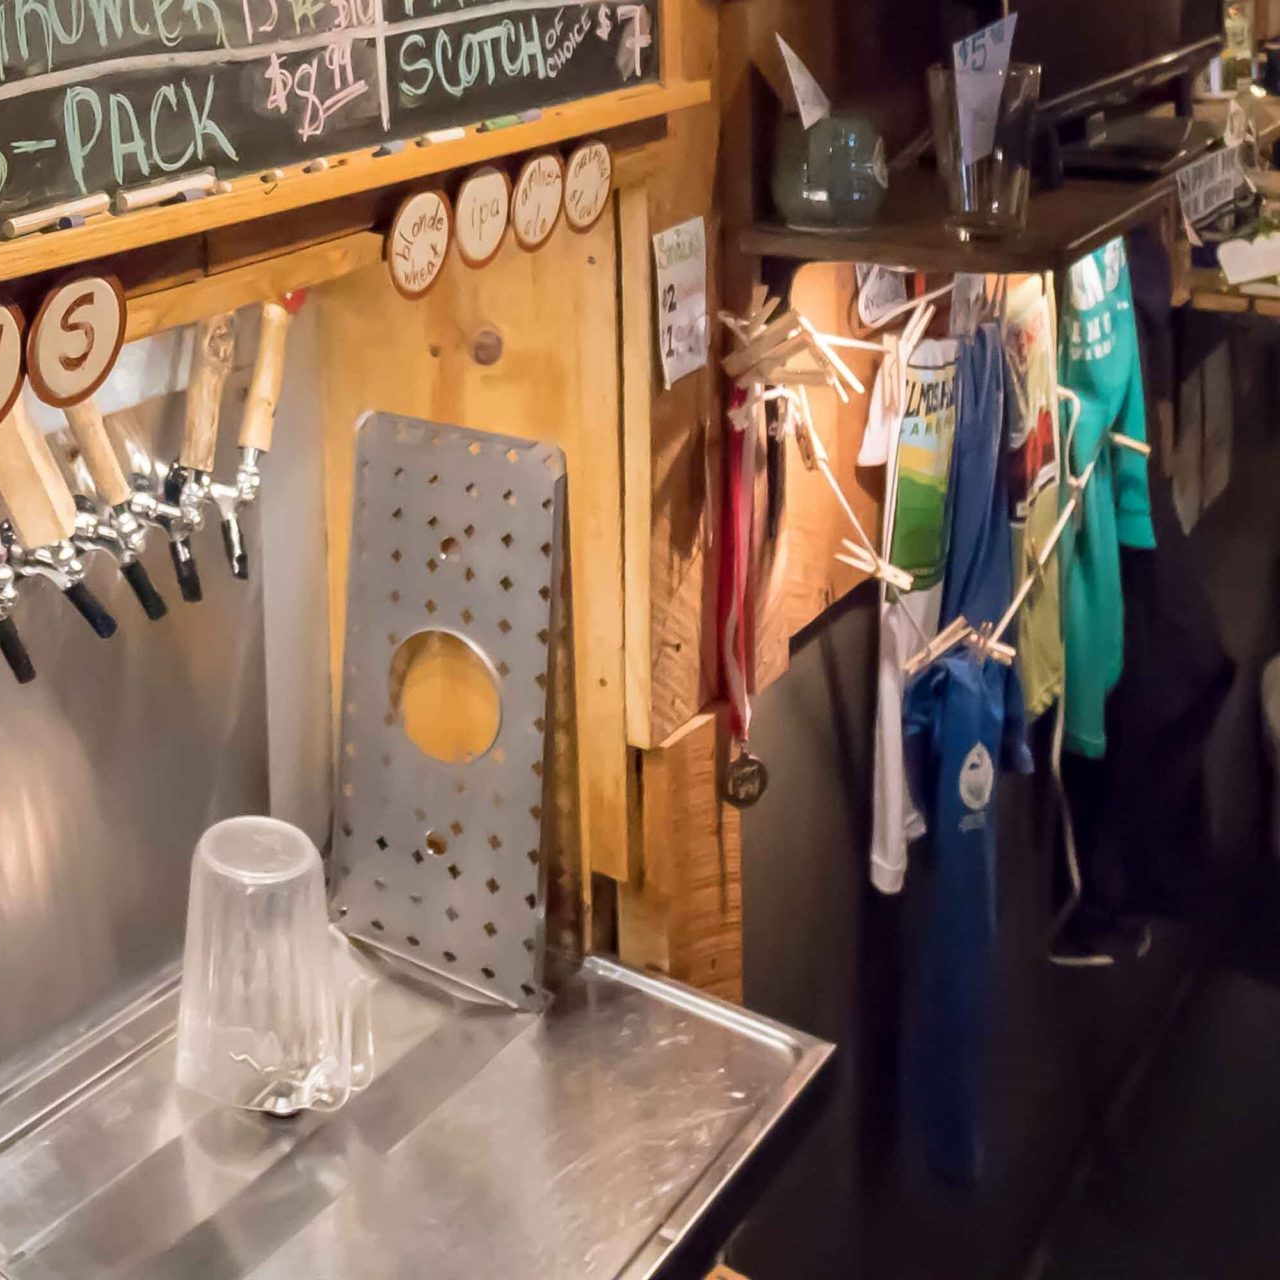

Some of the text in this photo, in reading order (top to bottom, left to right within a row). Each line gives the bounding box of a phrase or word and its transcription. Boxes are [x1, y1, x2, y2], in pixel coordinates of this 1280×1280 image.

[398, 2, 652, 98] SCOTCH OF CHOICE $7
